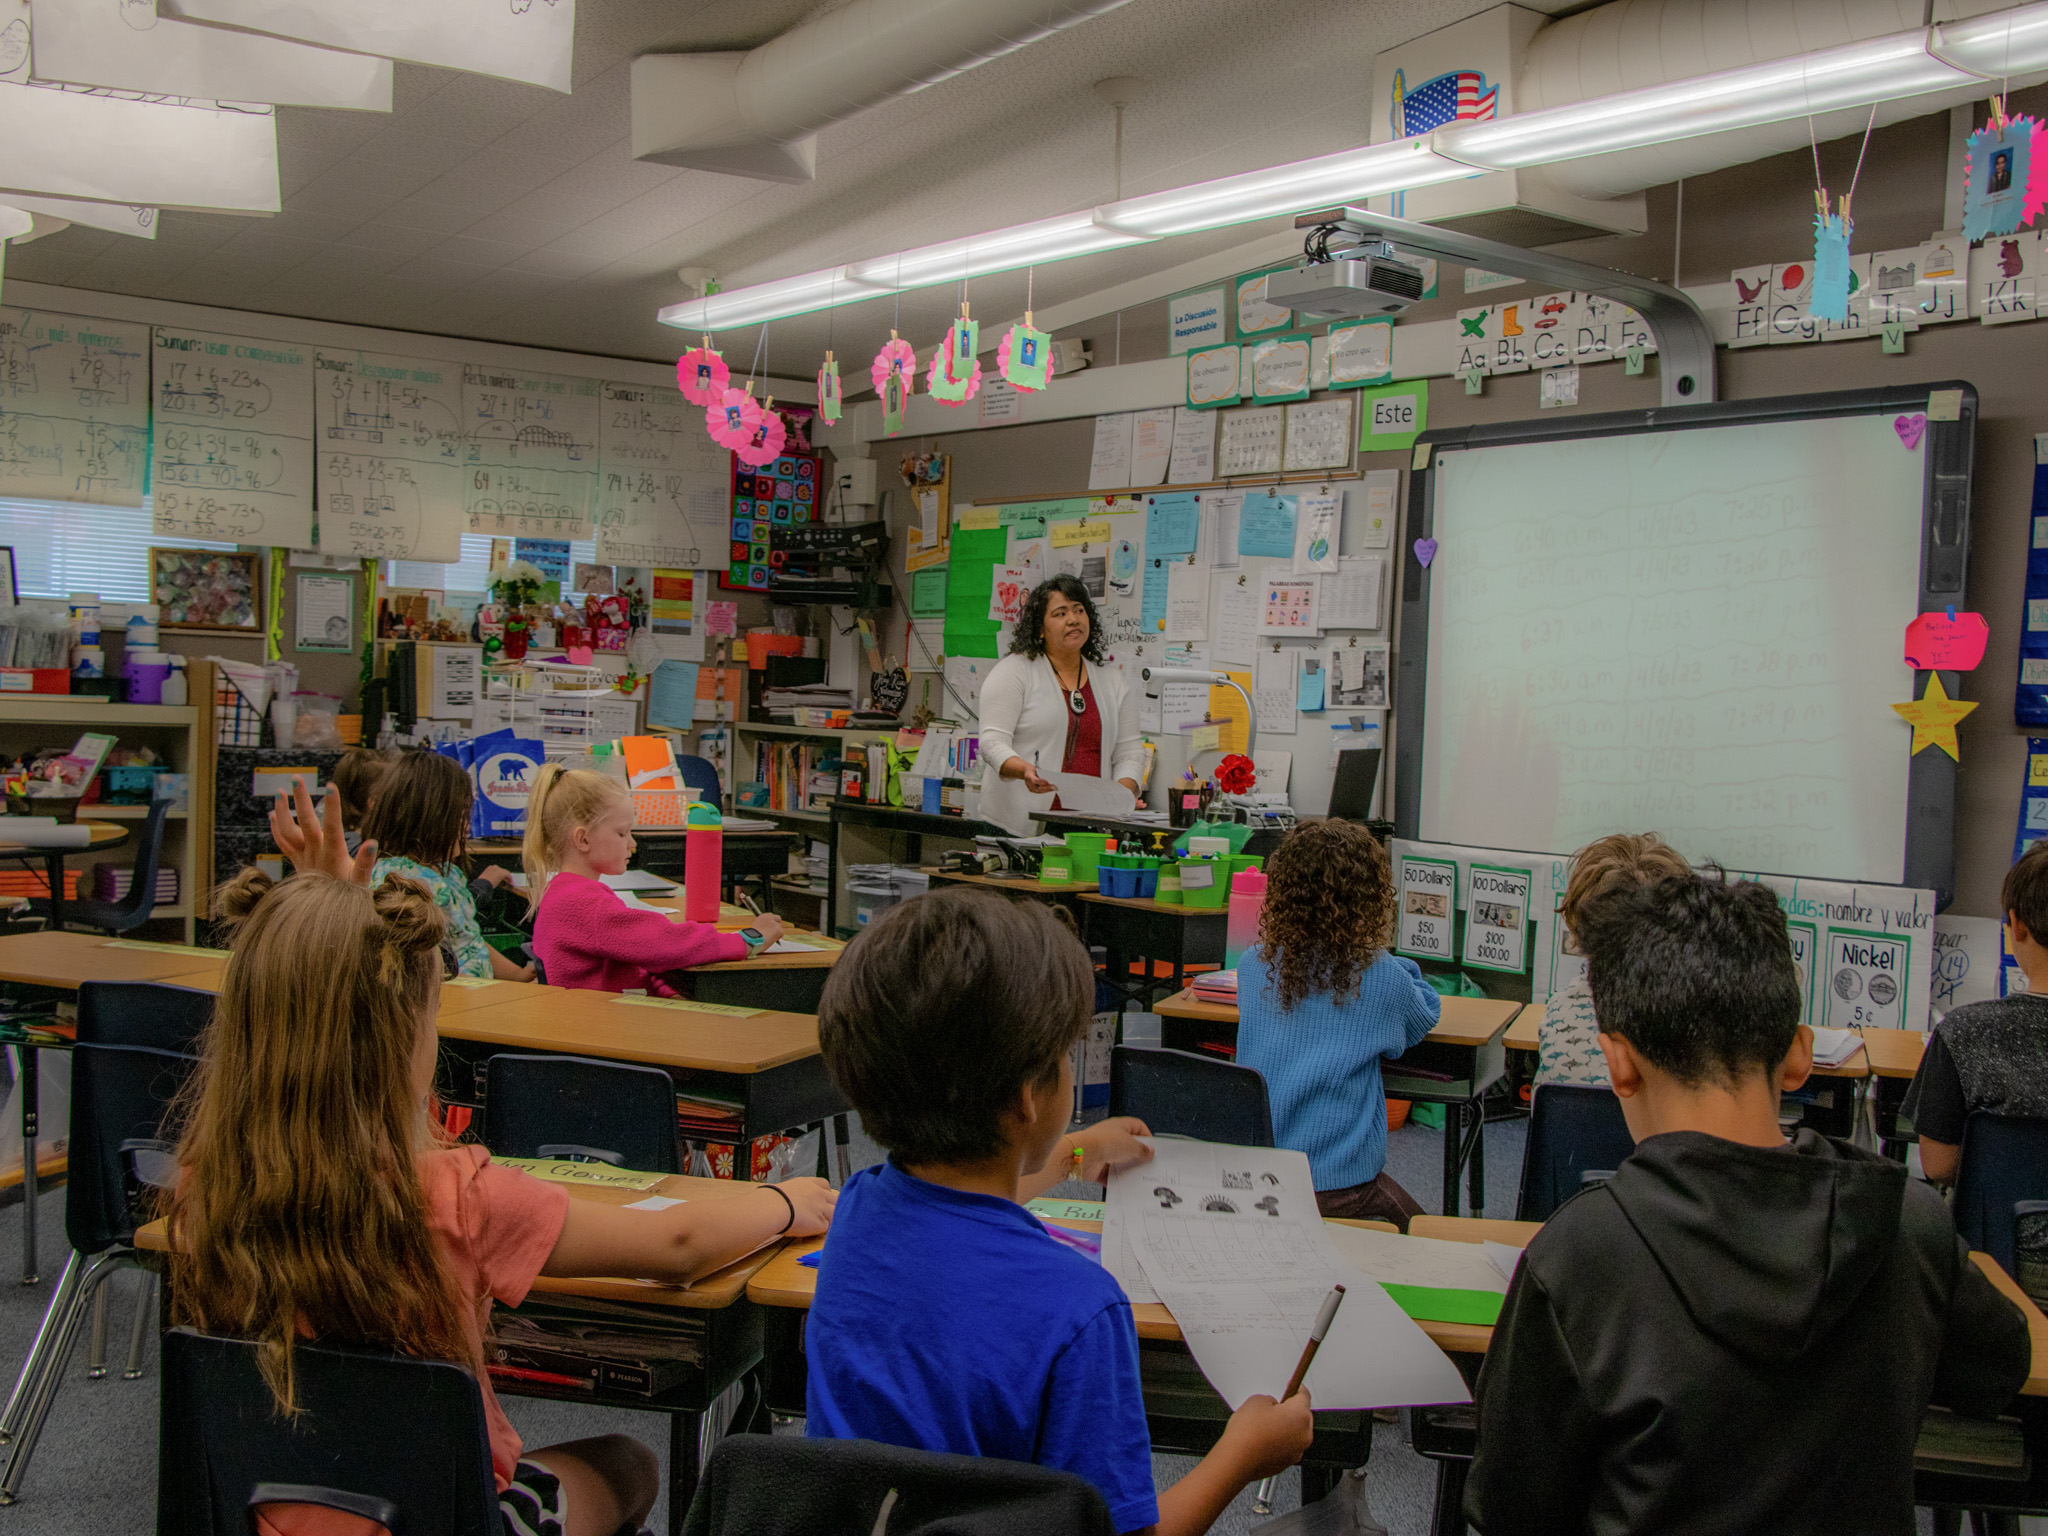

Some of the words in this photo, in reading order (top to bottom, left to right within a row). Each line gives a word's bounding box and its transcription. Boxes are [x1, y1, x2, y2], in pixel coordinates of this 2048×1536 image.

[1465, 272, 1475, 289] El
[1922, 284, 1955, 318] Jj
[1988, 280, 2026, 315] Kk
[1175, 315, 1184, 324] La
[1184, 307, 1217, 322] Discusión
[1736, 306, 1764, 338] Ff
[1773, 305, 1816, 338] Gg
[155, 327, 202, 352] Sumar:
[1175, 321, 1217, 337] Responsable
[1577, 325, 1607, 354] Dd
[1621, 321, 1648, 347] Ee
[1886, 329, 1900, 346] V
[1498, 338, 1525, 365] Bb
[1534, 332, 1565, 359] Cc
[315, 352, 353, 374] Sumar:
[1202, 364, 1230, 376] observado
[1459, 347, 1486, 371] Aa
[604, 382, 645, 402] Sumar:
[1375, 403, 1412, 425] Este
[1931, 651, 1953, 661] YET
[1404, 868, 1418, 882] 50
[1418, 869, 1452, 886] Dollars
[1473, 875, 1489, 890] 100
[1490, 878, 1527, 897] Dollars
[1825, 888, 1873, 923] nombre
[1880, 909, 1890, 933] y
[1895, 893, 1933, 929] valor
[1418, 920, 1434, 934] $50
[1411, 934, 1439, 950] $50.00
[1485, 931, 1506, 946] $100
[1477, 945, 1510, 961] $100.00
[1841, 943, 1895, 971] Nickel
[550, 1163, 645, 1184] Gomes
[617, 1373, 643, 1384] PEARSON
